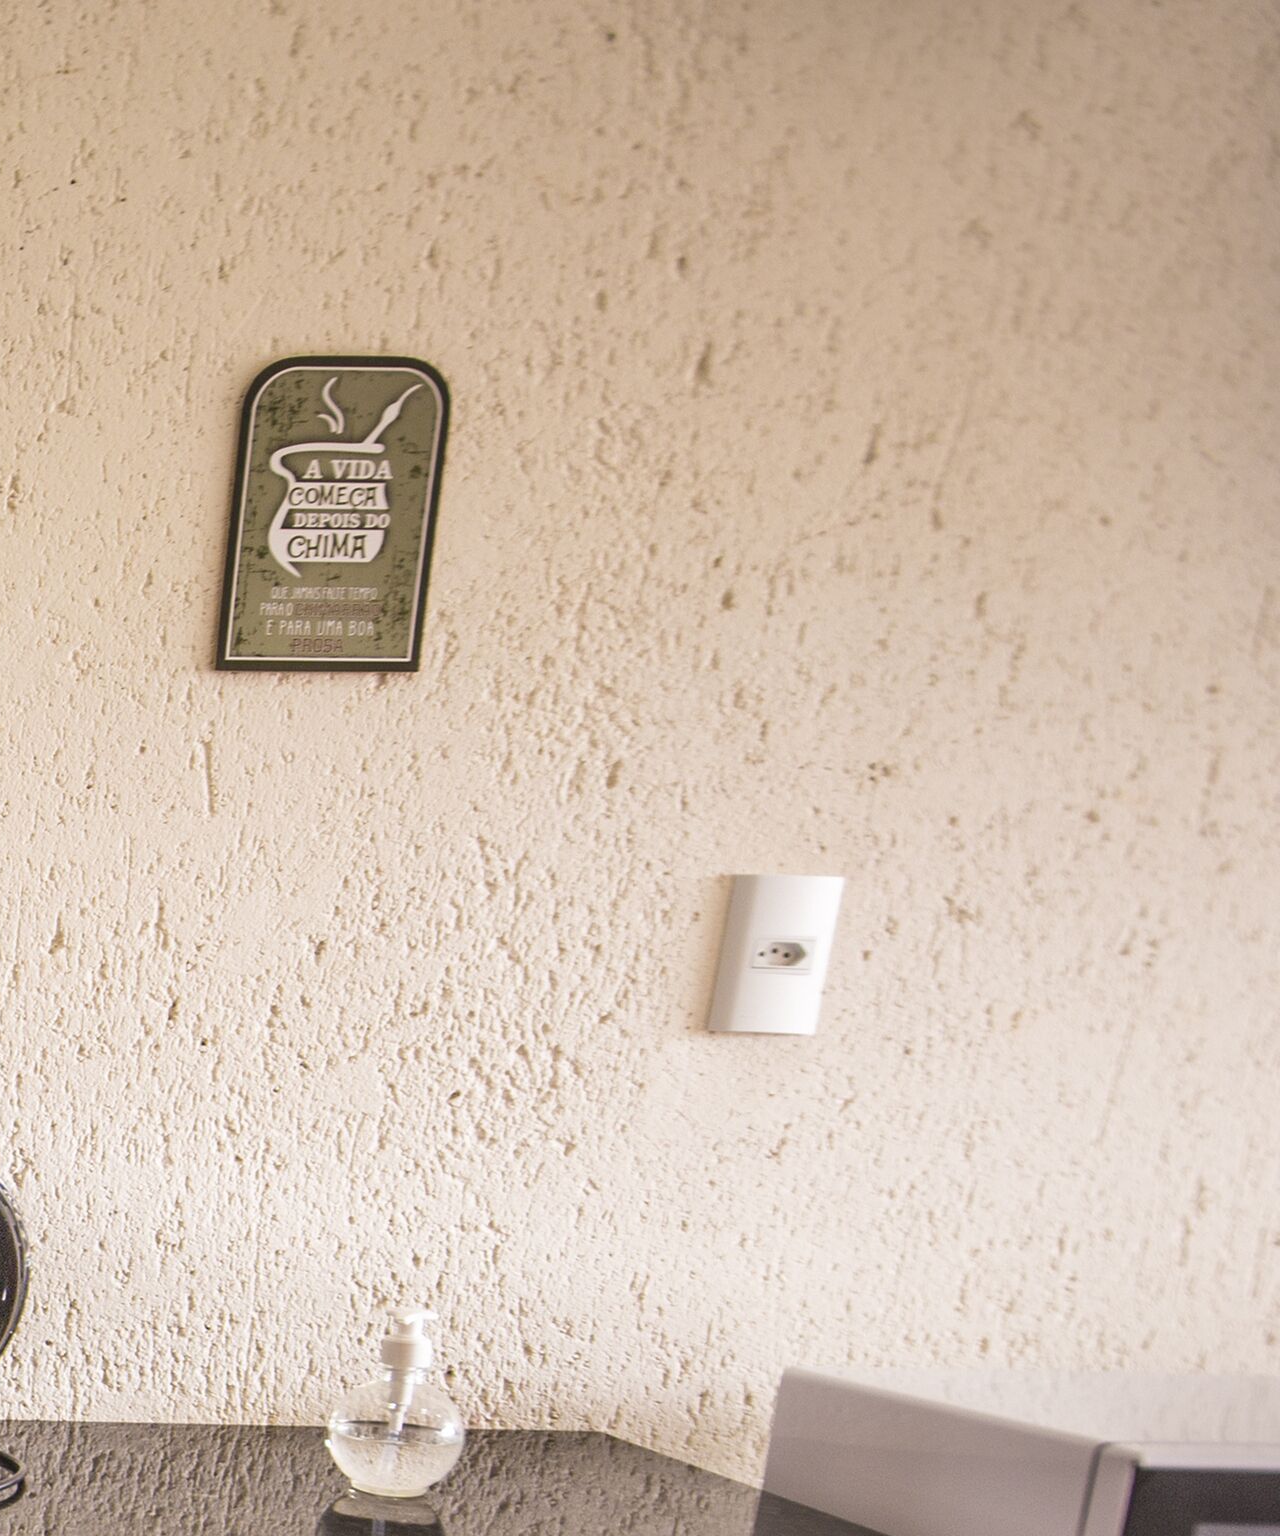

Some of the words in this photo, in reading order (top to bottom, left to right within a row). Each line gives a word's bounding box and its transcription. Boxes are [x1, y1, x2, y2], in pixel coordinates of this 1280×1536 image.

[302, 459, 323, 479] A
[331, 459, 394, 480] VIDA
[292, 512, 361, 528] DEPOIS
[364, 513, 391, 529] DO
[287, 533, 368, 559] CHIMA
[271, 586, 289, 599] QUE
[348, 587, 378, 600] TEMPO
[260, 602, 284, 616] PARA
[285, 602, 294, 616] O
[266, 619, 274, 636] E
[279, 620, 311, 636] PARA
[316, 620, 343, 636] UMA
[348, 620, 375, 636] BOA
[290, 638, 343, 653] PROSA
